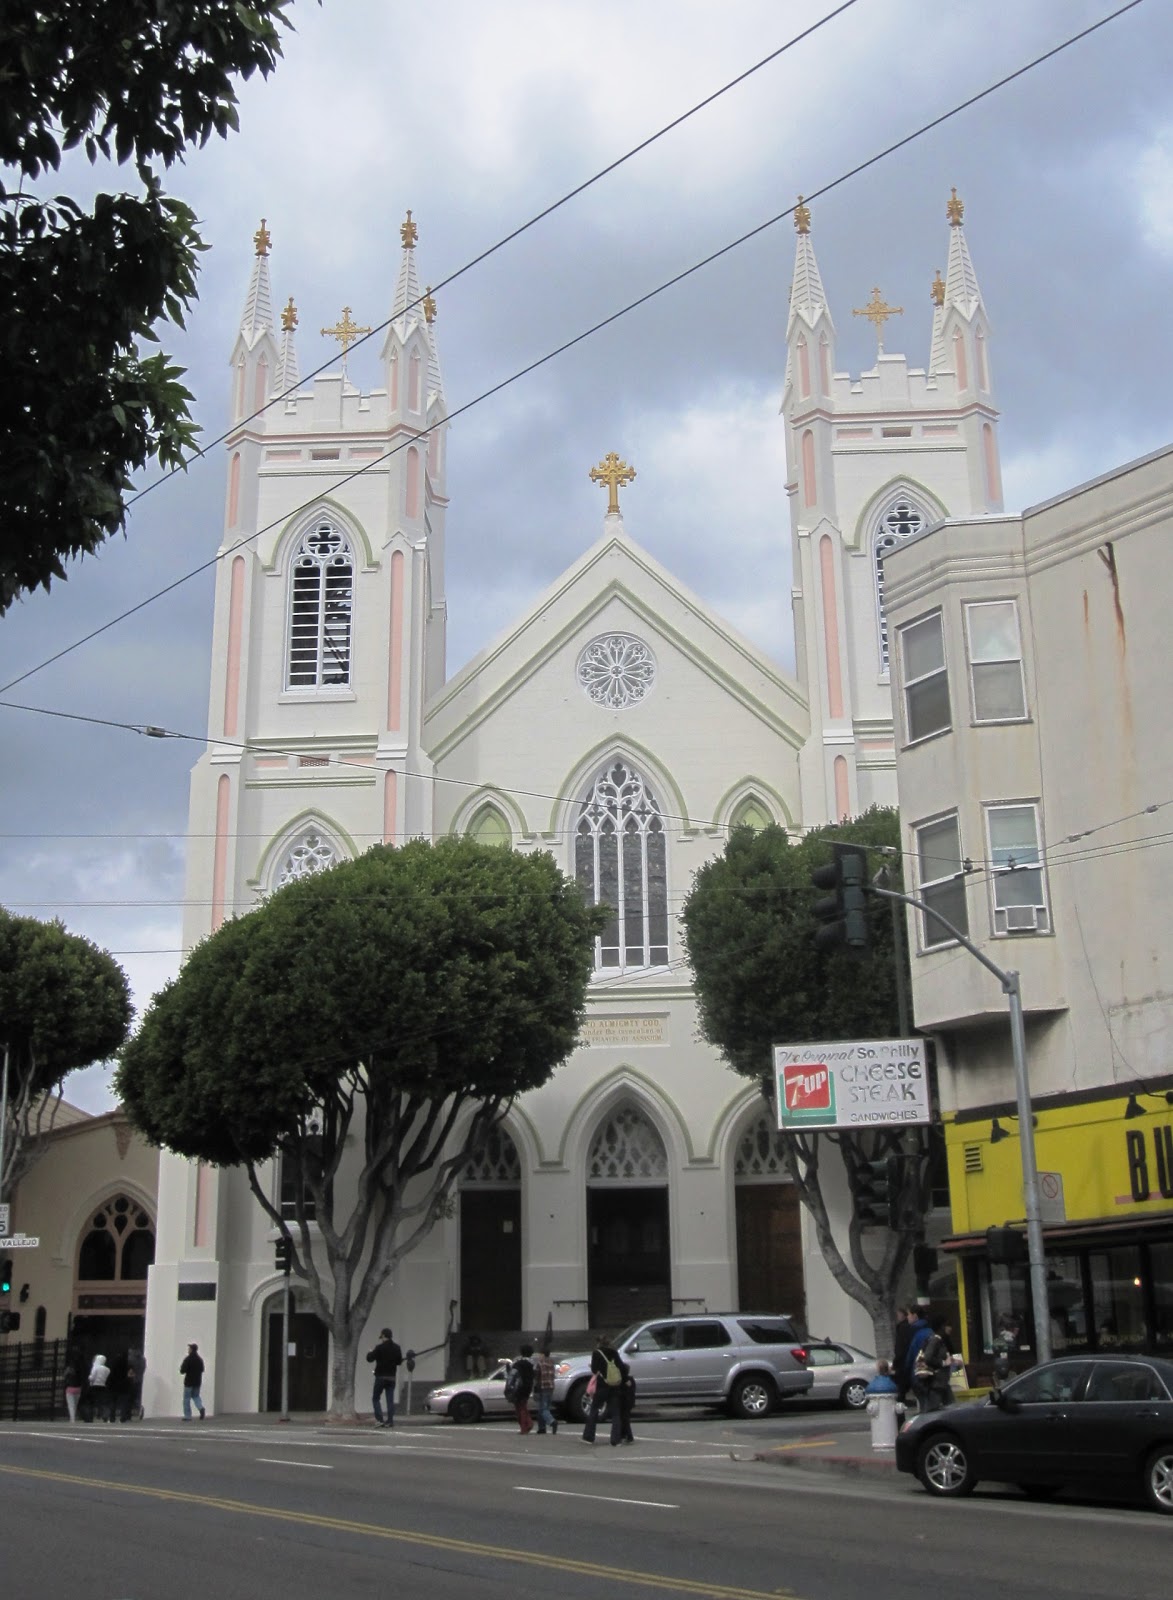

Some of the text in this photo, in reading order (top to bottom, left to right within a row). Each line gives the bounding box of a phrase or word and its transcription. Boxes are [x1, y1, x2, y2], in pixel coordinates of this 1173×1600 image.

[779, 1051, 800, 1065] The
[802, 1047, 854, 1063] Original
[857, 1047, 878, 1059] So.
[840, 1061, 922, 1082] CHEESE
[849, 1083, 916, 1103] STEAK
[850, 1110, 918, 1122] SANDWICHES
